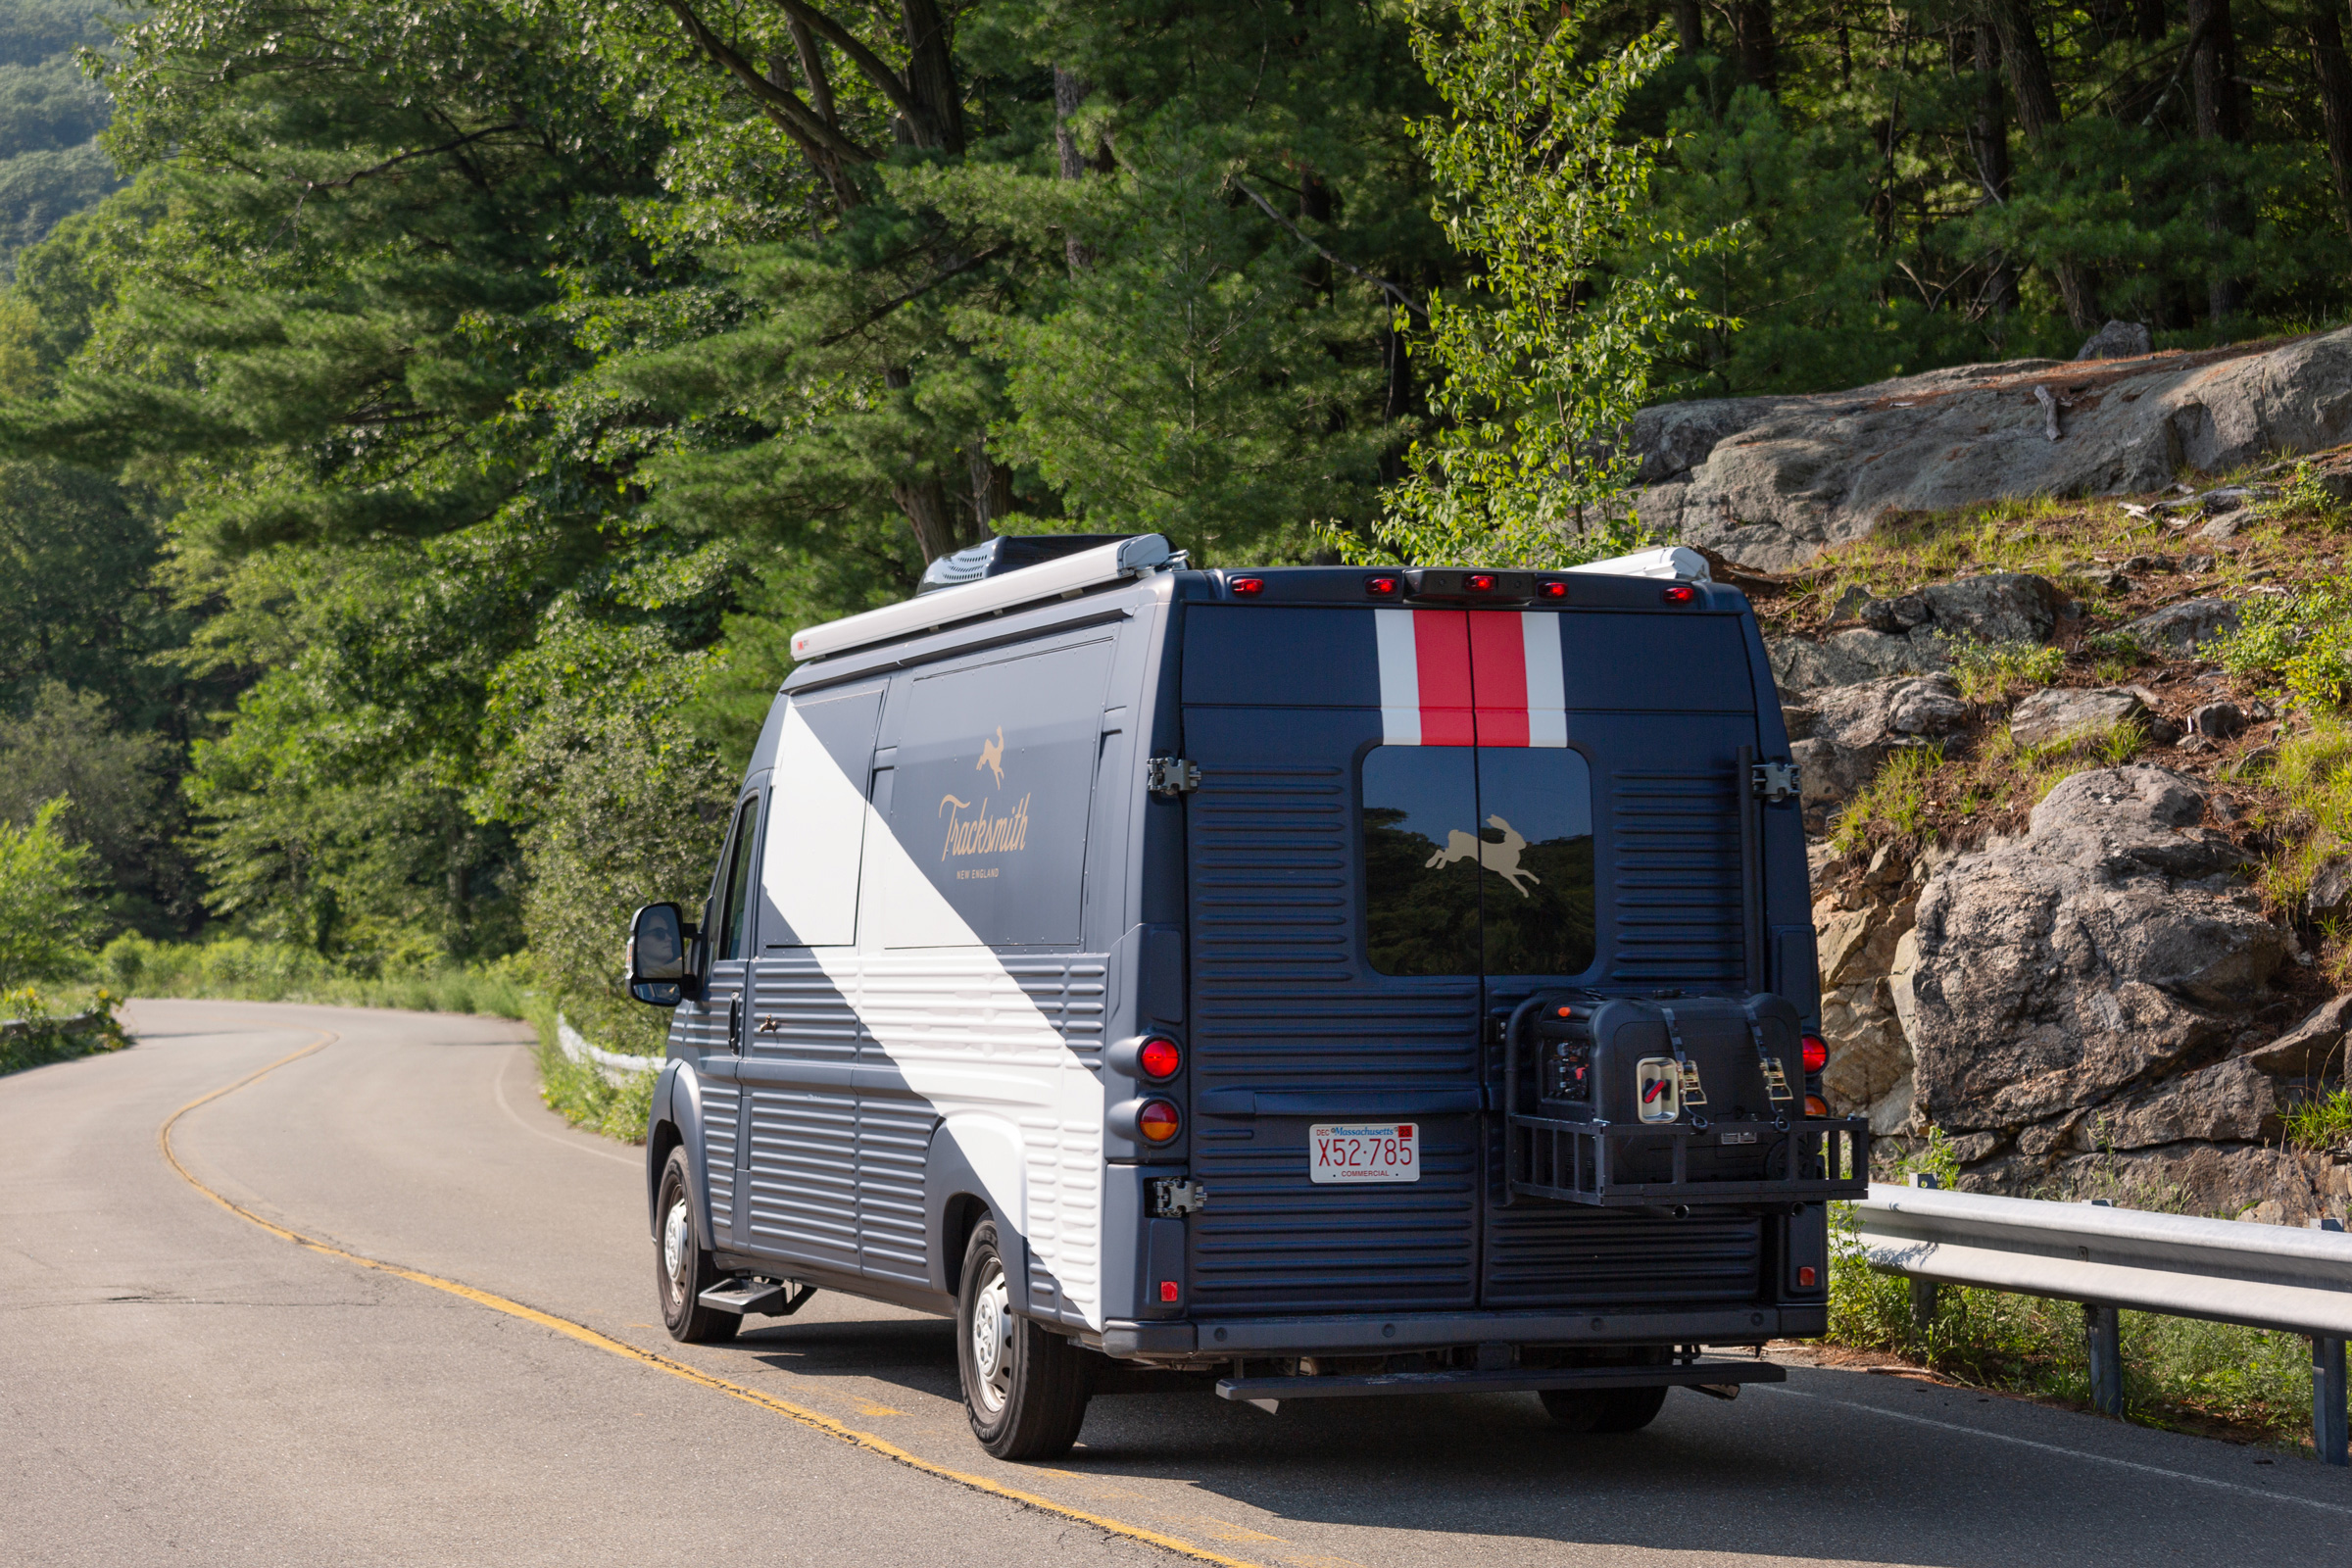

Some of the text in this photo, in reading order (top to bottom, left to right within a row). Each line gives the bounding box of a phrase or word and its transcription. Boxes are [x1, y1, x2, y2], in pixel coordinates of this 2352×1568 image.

[939, 792, 1031, 862] Tracksmith
[956, 868, 999, 879] NEW ENGLAND
[1334, 1126, 1394, 1136] Massachusetts
